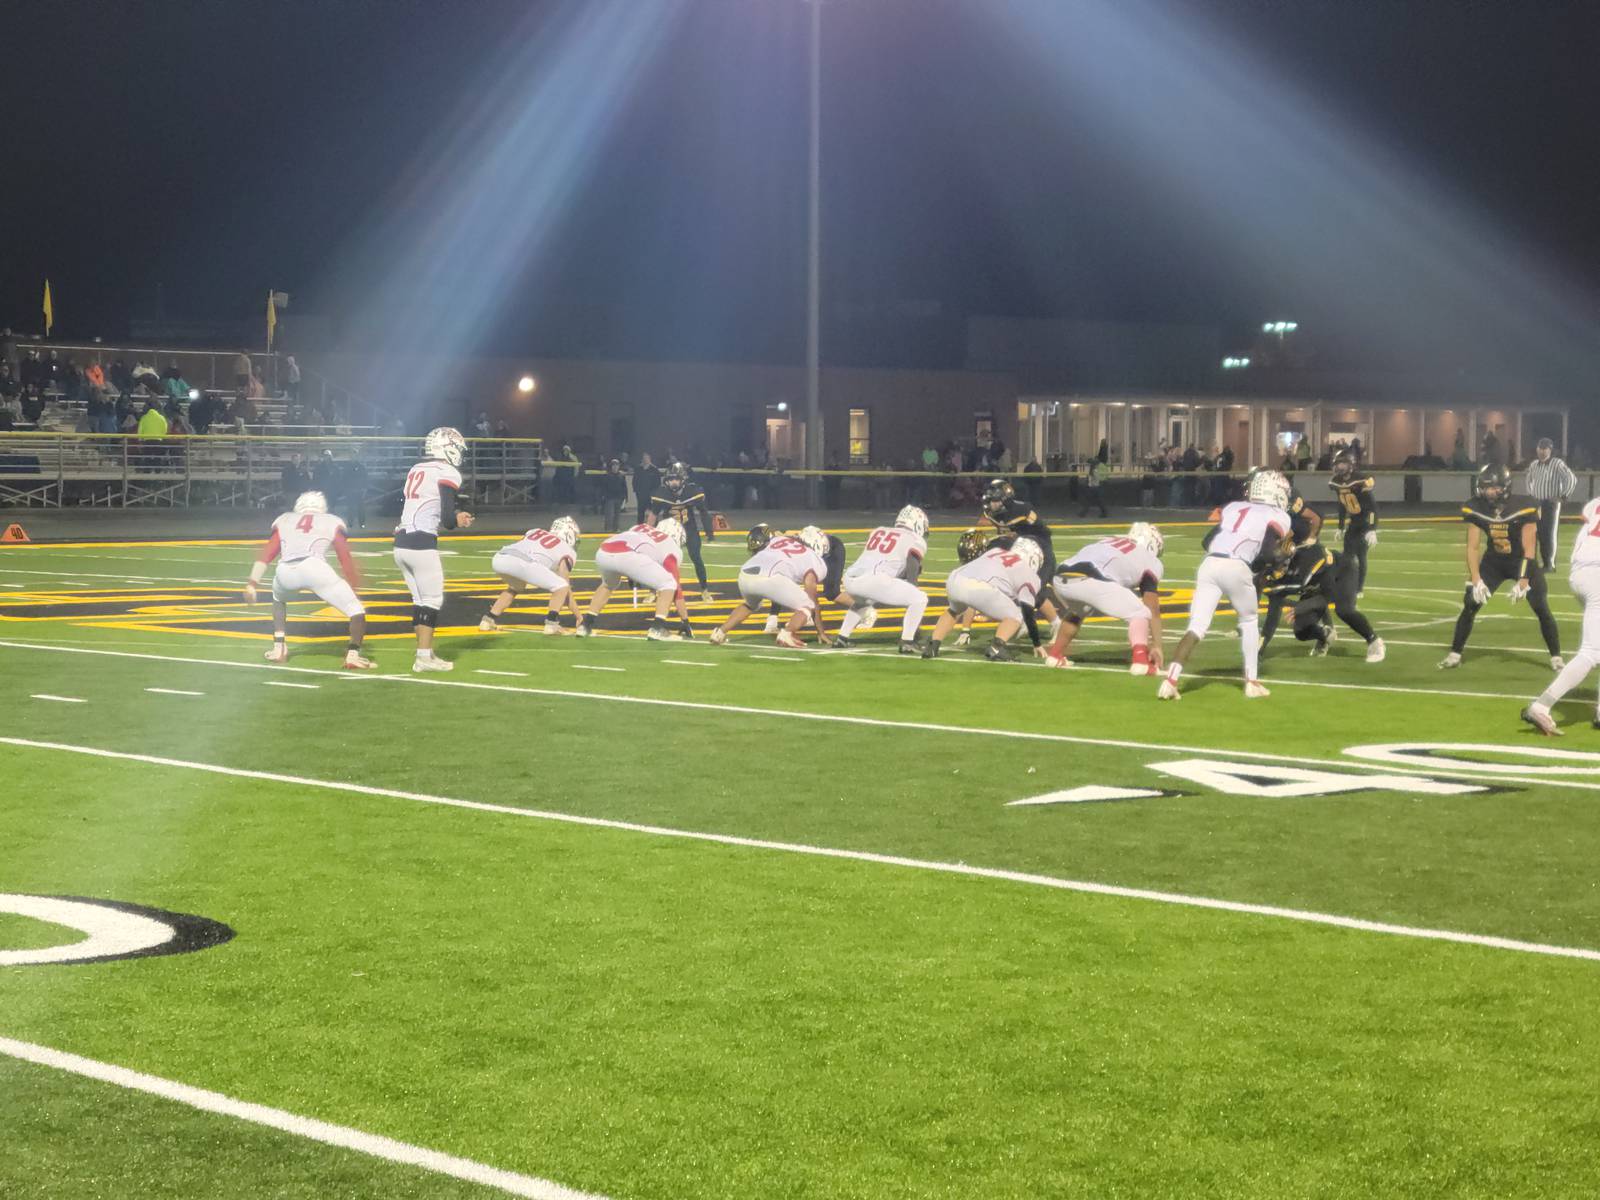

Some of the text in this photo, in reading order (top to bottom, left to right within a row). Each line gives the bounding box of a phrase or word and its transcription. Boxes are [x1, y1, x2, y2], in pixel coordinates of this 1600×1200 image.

[406, 471, 425, 499] 12
[296, 514, 314, 534] 4
[1232, 506, 1250, 533] 1
[867, 529, 900, 554] 65
